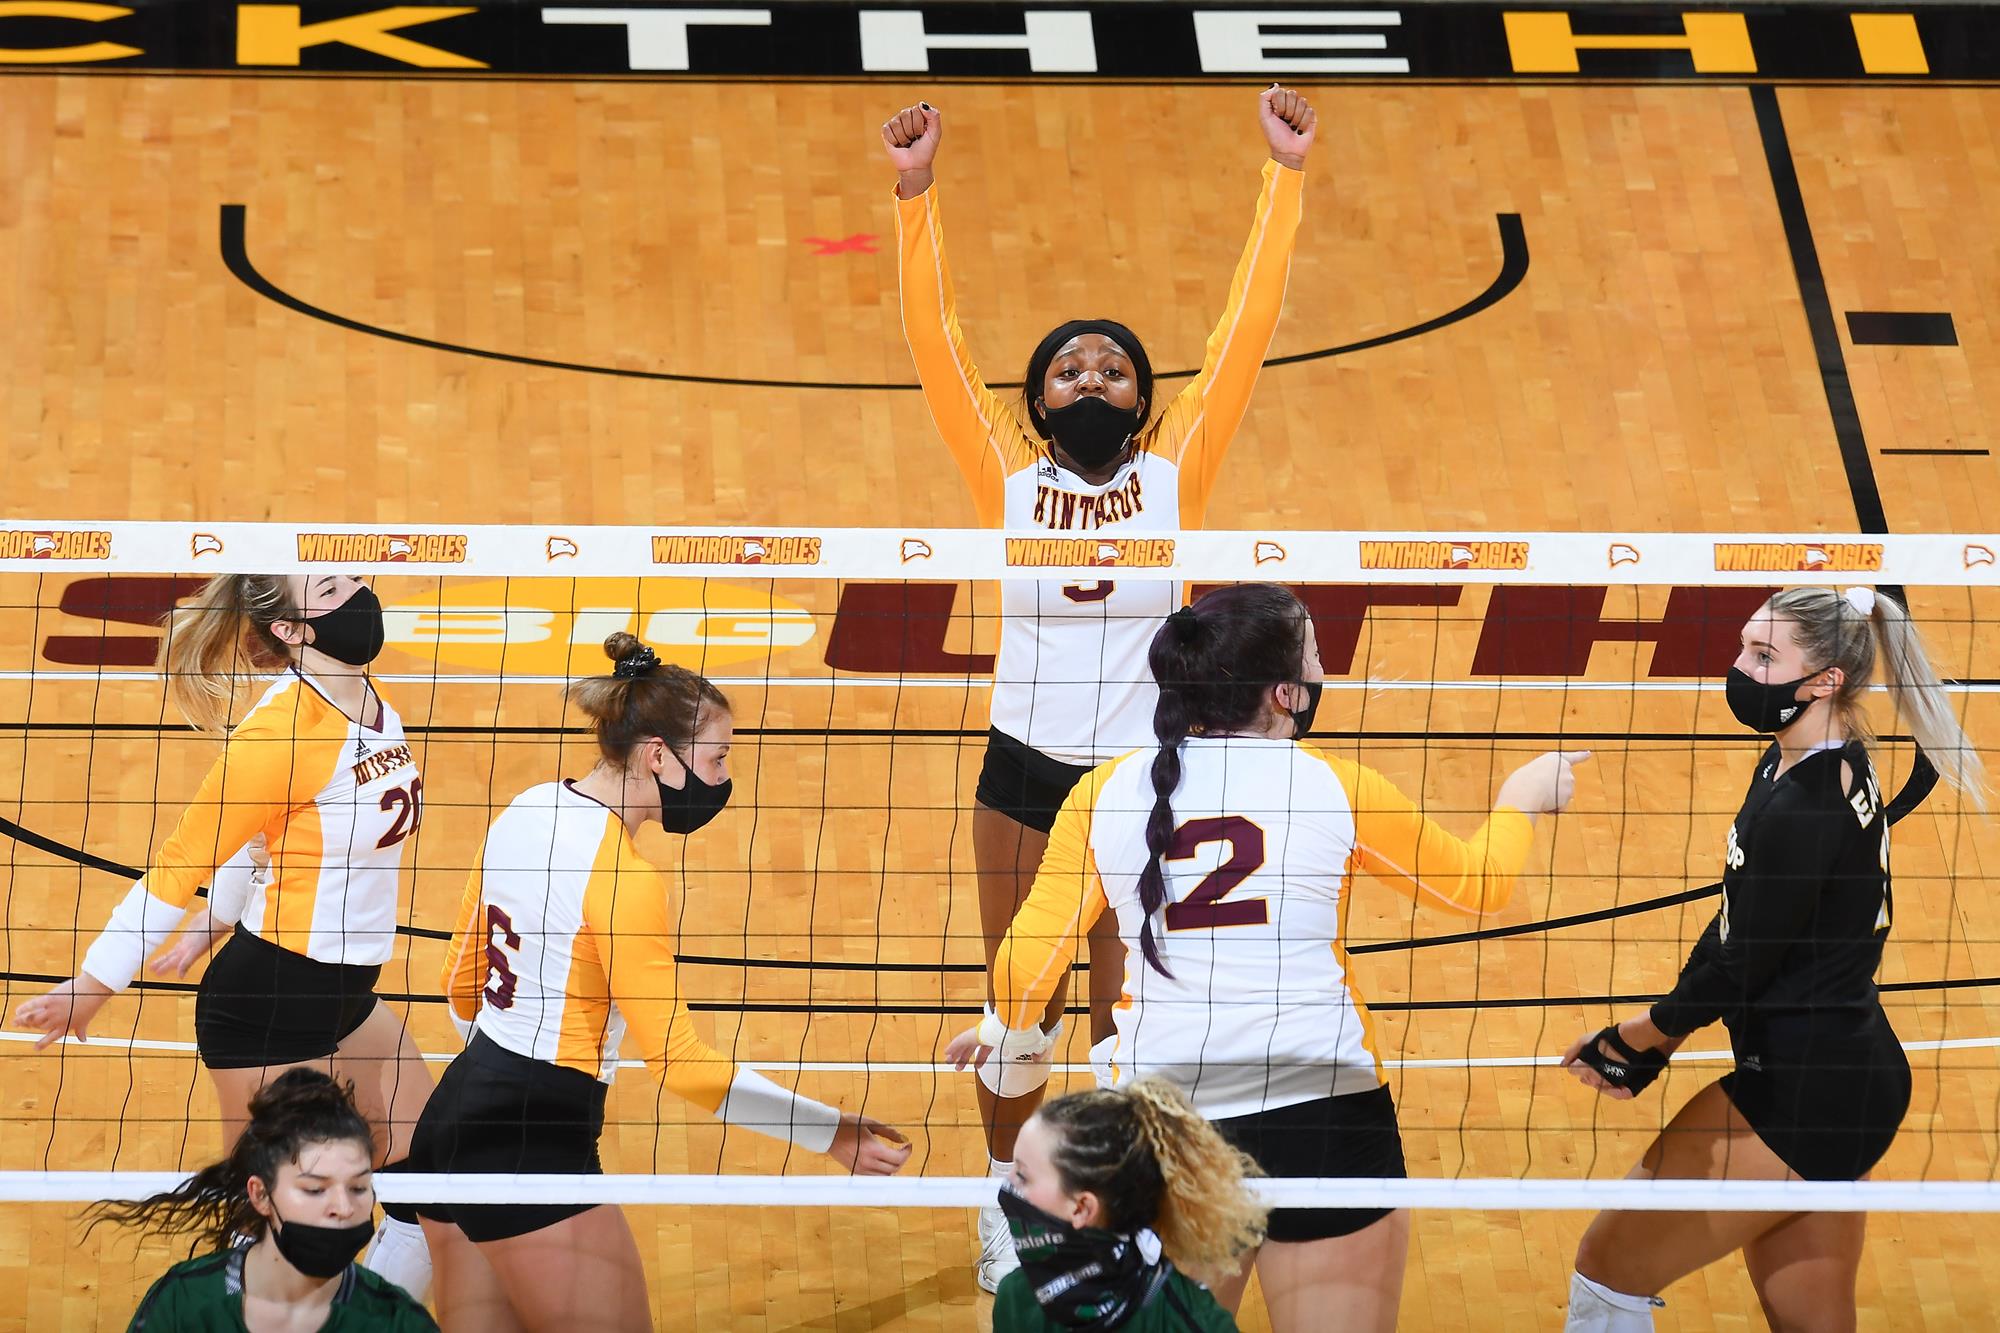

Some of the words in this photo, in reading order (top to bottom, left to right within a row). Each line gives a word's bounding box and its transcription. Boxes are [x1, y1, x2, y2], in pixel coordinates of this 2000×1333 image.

[542, 7, 1409, 72] THE
[1503, 12, 1929, 73] HI
[52, 531, 112, 560] EAGLES
[297, 534, 390, 562] WINTHROP
[407, 535, 468, 563] EAGLES
[652, 536, 744, 564] WINTHROP
[763, 537, 822, 565] EAGLES
[1005, 538, 1098, 566] WINTHROP
[1115, 539, 1176, 567] EAGLES
[1360, 541, 1451, 569] WINTHROP
[1469, 542, 1529, 570] EAGLES
[1714, 543, 1806, 571] WINTHROP
[1823, 544, 1884, 571] EAGLES
[380, 605, 816, 647] BIG
[1165, 815, 1269, 932] 2
[484, 904, 520, 1011] 6
